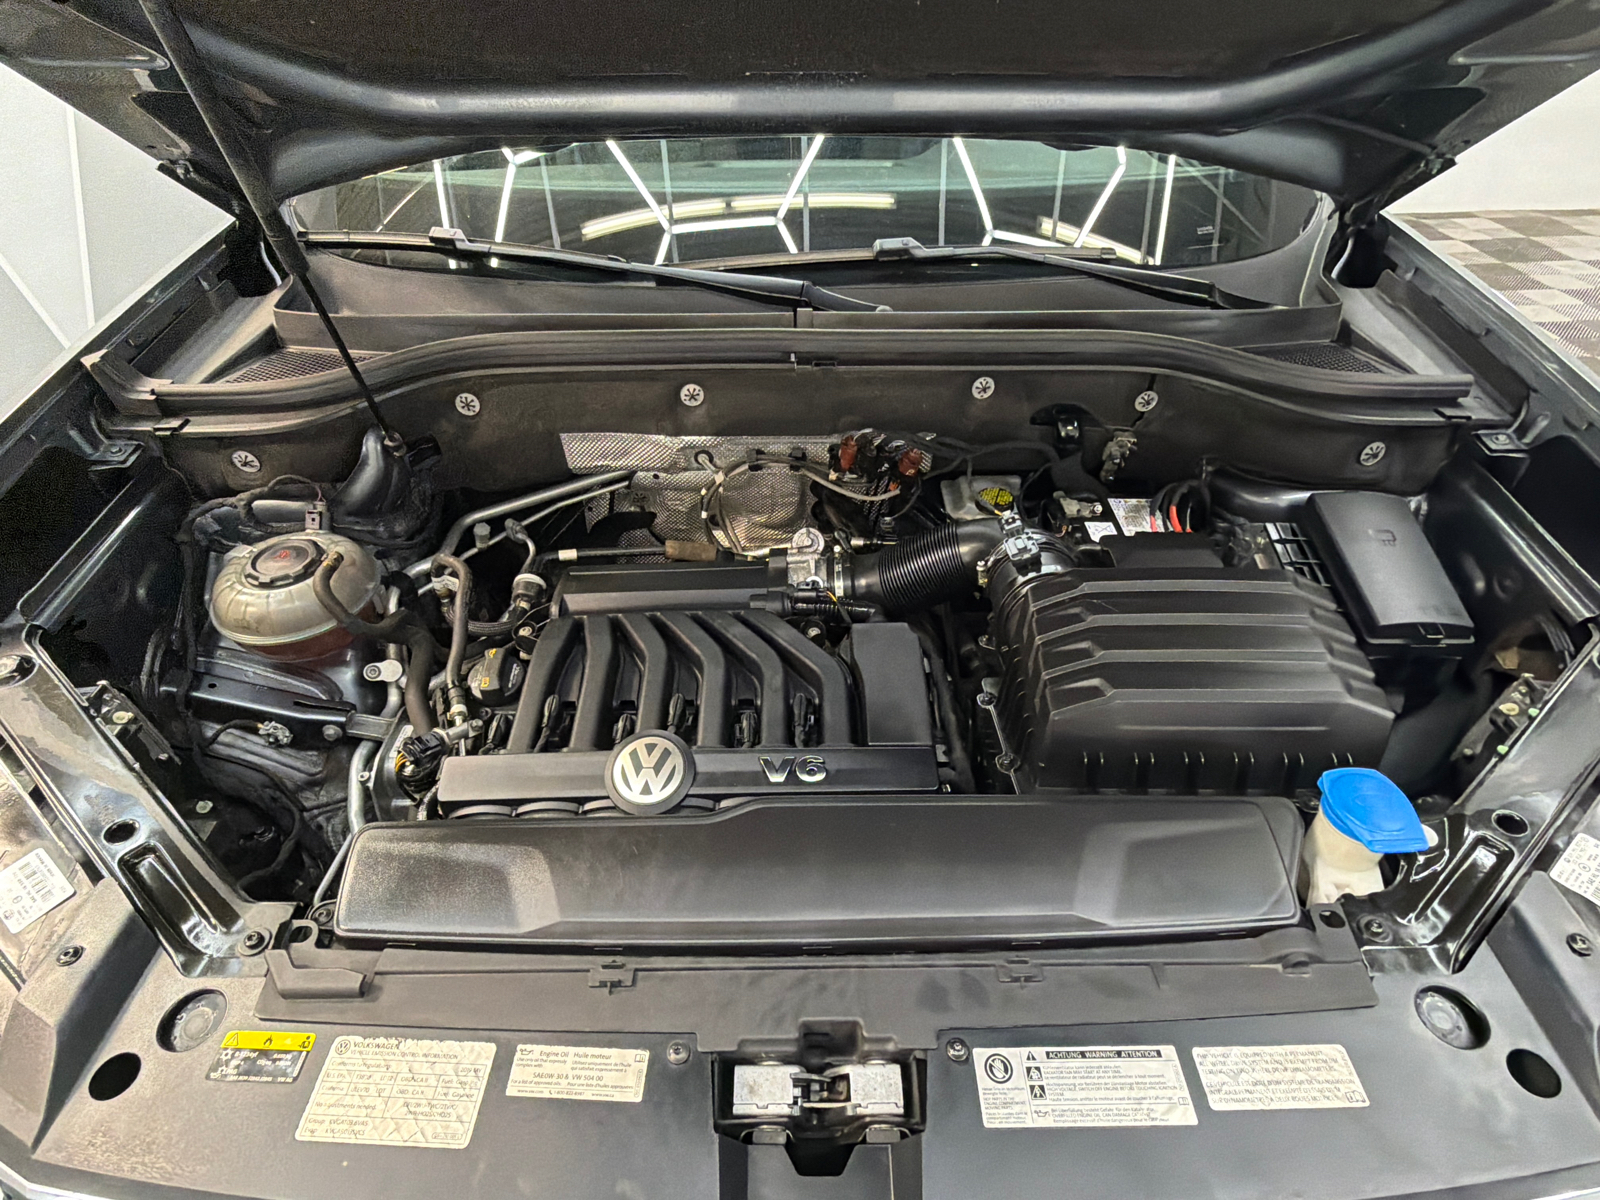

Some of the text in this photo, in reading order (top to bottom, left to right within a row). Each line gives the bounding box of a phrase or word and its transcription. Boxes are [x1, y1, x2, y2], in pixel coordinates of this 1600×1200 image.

[759, 756, 827, 783] V6
[353, 1041, 400, 1050] VOLKSWAGEN
[421, 1052, 458, 1060] INFORMATION
[539, 1050, 560, 1058] Engine
[573, 1051, 590, 1059] Huile
[1048, 1050, 1158, 1059] ACHTUNG WARNING ATTENTION
